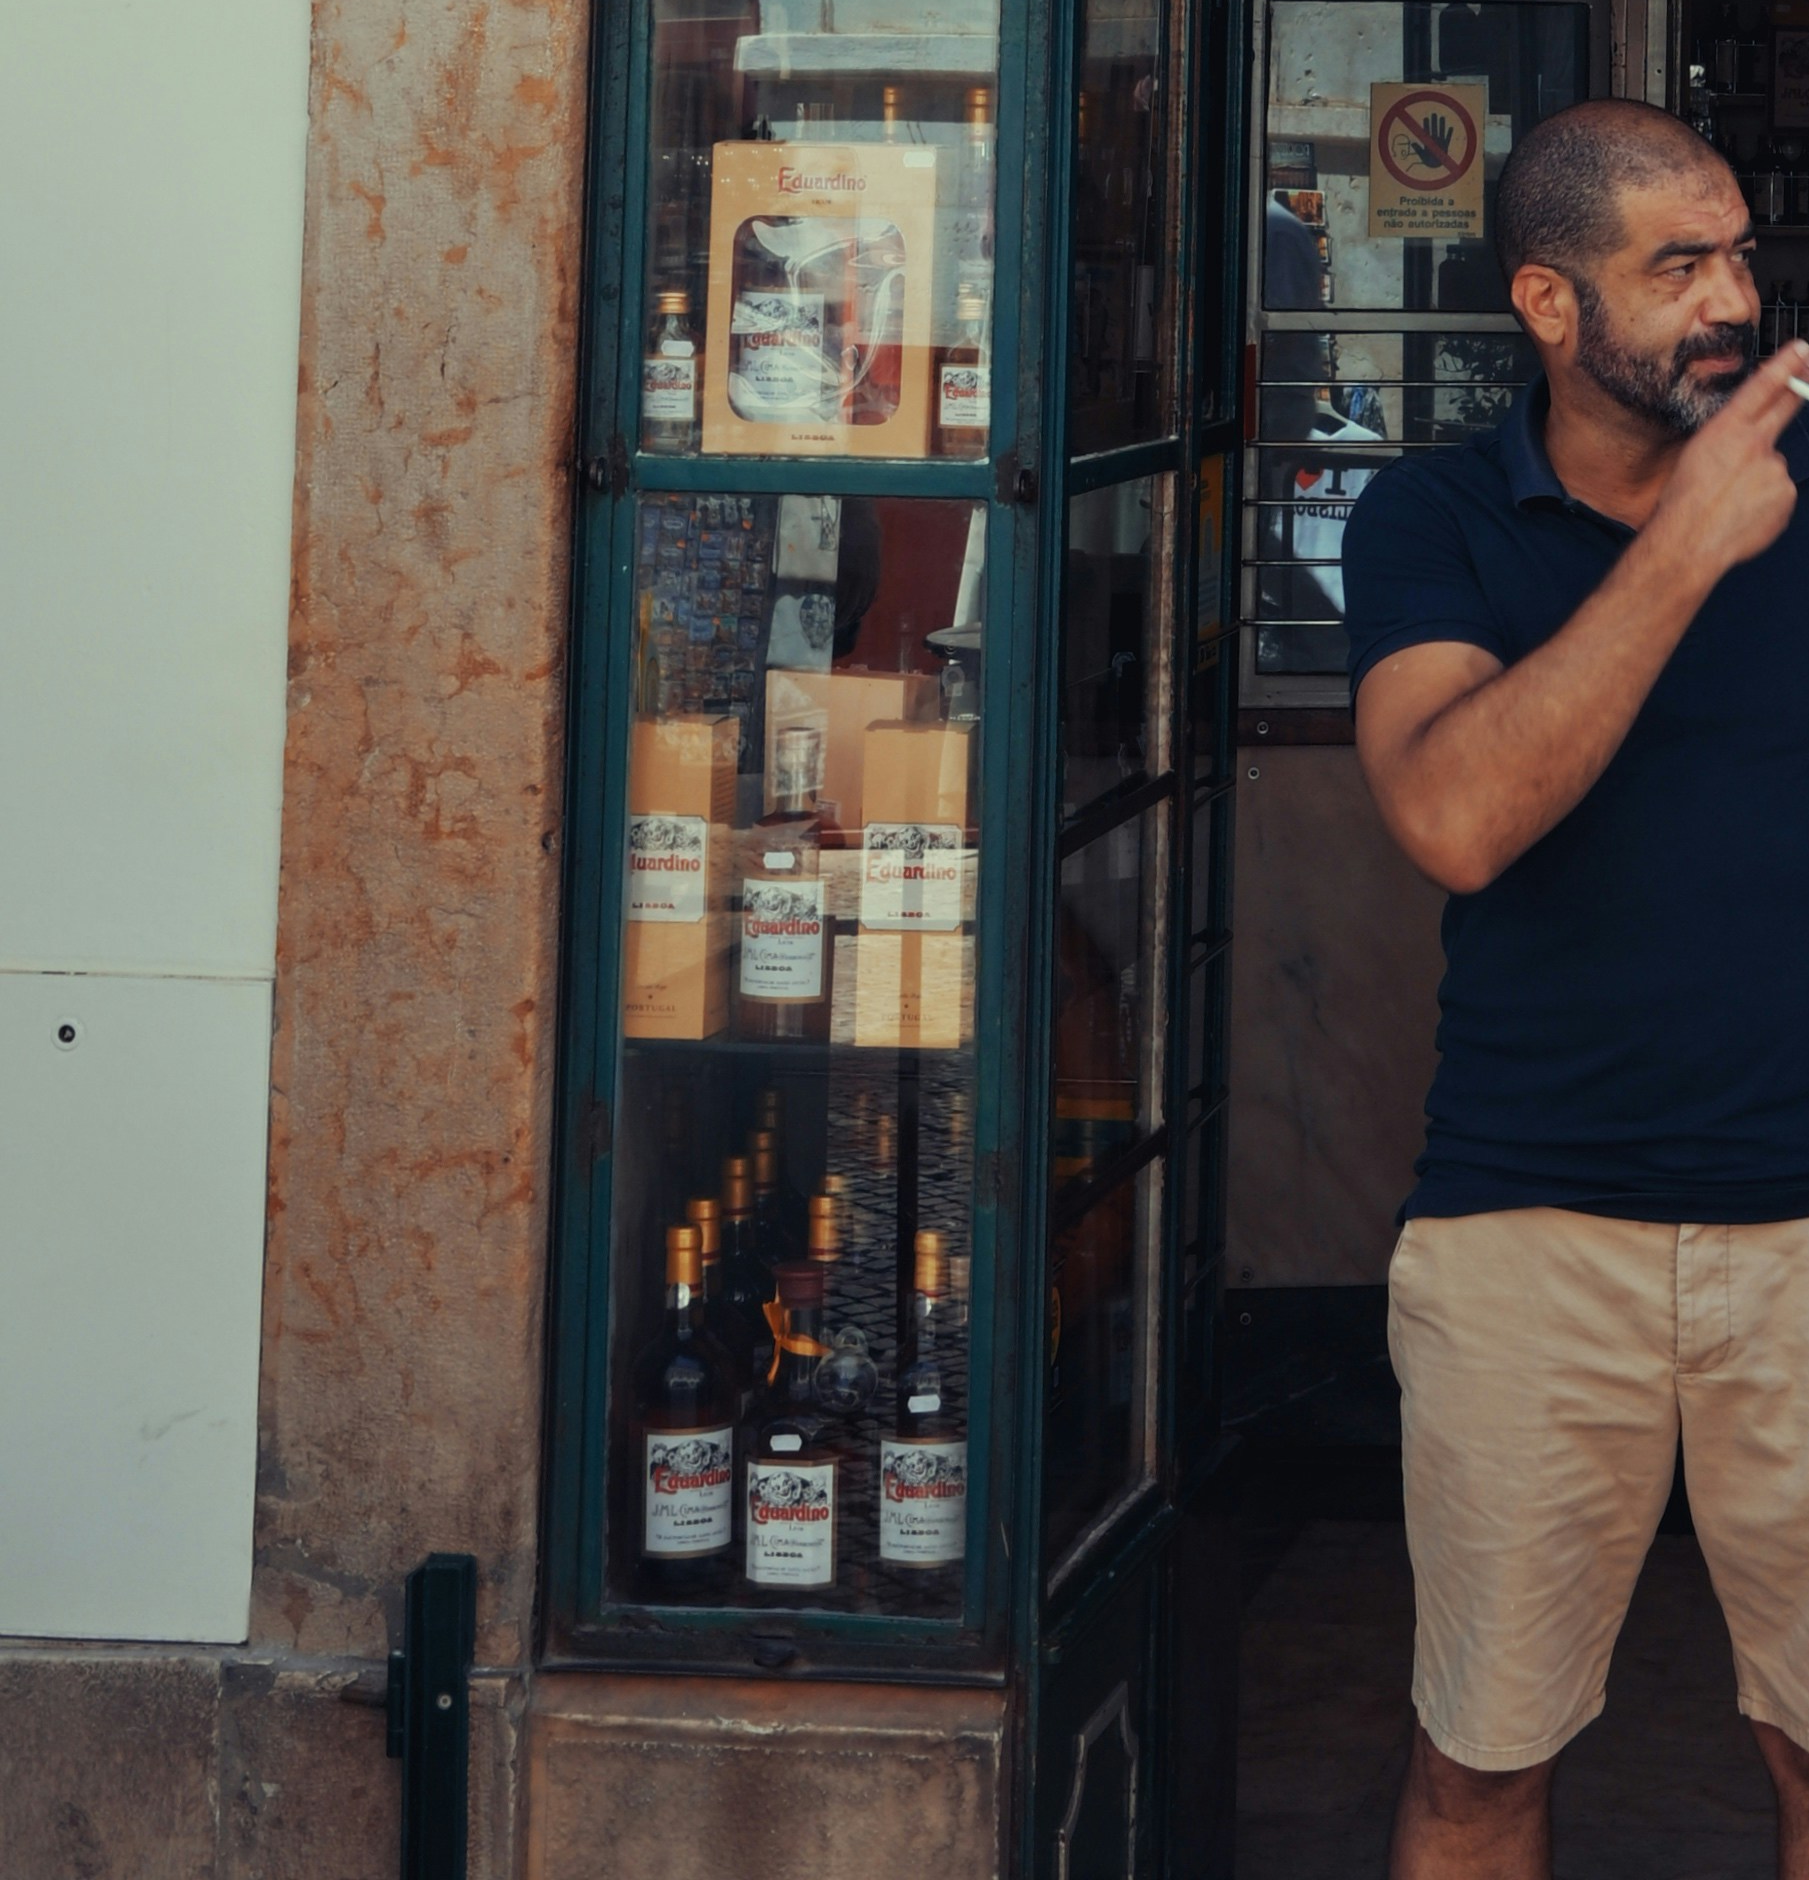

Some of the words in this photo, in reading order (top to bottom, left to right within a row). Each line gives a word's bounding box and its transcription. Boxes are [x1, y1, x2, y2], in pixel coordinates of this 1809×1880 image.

[777, 165, 867, 195] Eduardino
[1399, 196, 1444, 207] Proibida
[1448, 198, 1455, 207] a
[1376, 208, 1417, 218] entrada
[1421, 209, 1428, 218] a
[1432, 209, 1477, 219] pessoas
[1383, 218, 1403, 228] não
[1408, 218, 1470, 229] autorizadas
[630, 852, 702, 872] uardino
[865, 852, 957, 884] Eduardino
[744, 916, 821, 939] Eduardino
[754, 964, 793, 972] LISBOA
[653, 1464, 732, 1495] Eduardino
[884, 1471, 965, 1503] Eduardino
[750, 1495, 830, 1525] Eduardino
